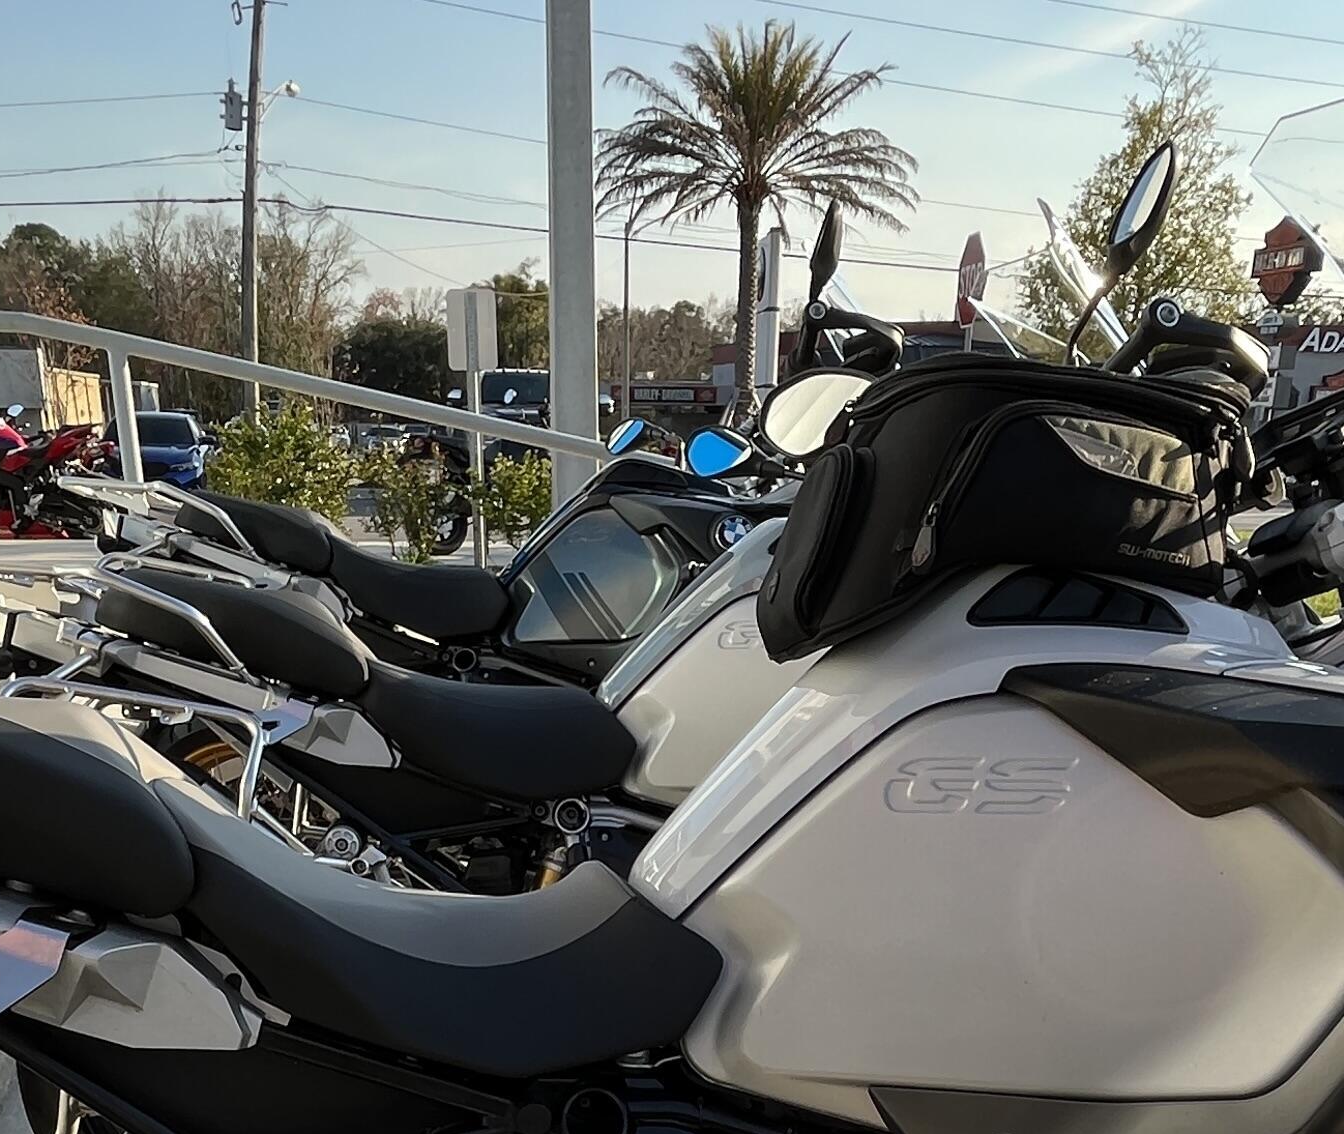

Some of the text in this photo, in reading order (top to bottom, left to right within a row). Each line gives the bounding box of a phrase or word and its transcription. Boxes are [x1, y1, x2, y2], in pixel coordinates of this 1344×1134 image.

[959, 261, 983, 299] STOP
[1118, 543, 1192, 566] SW-MOTECH
[883, 757, 1080, 815] GS
